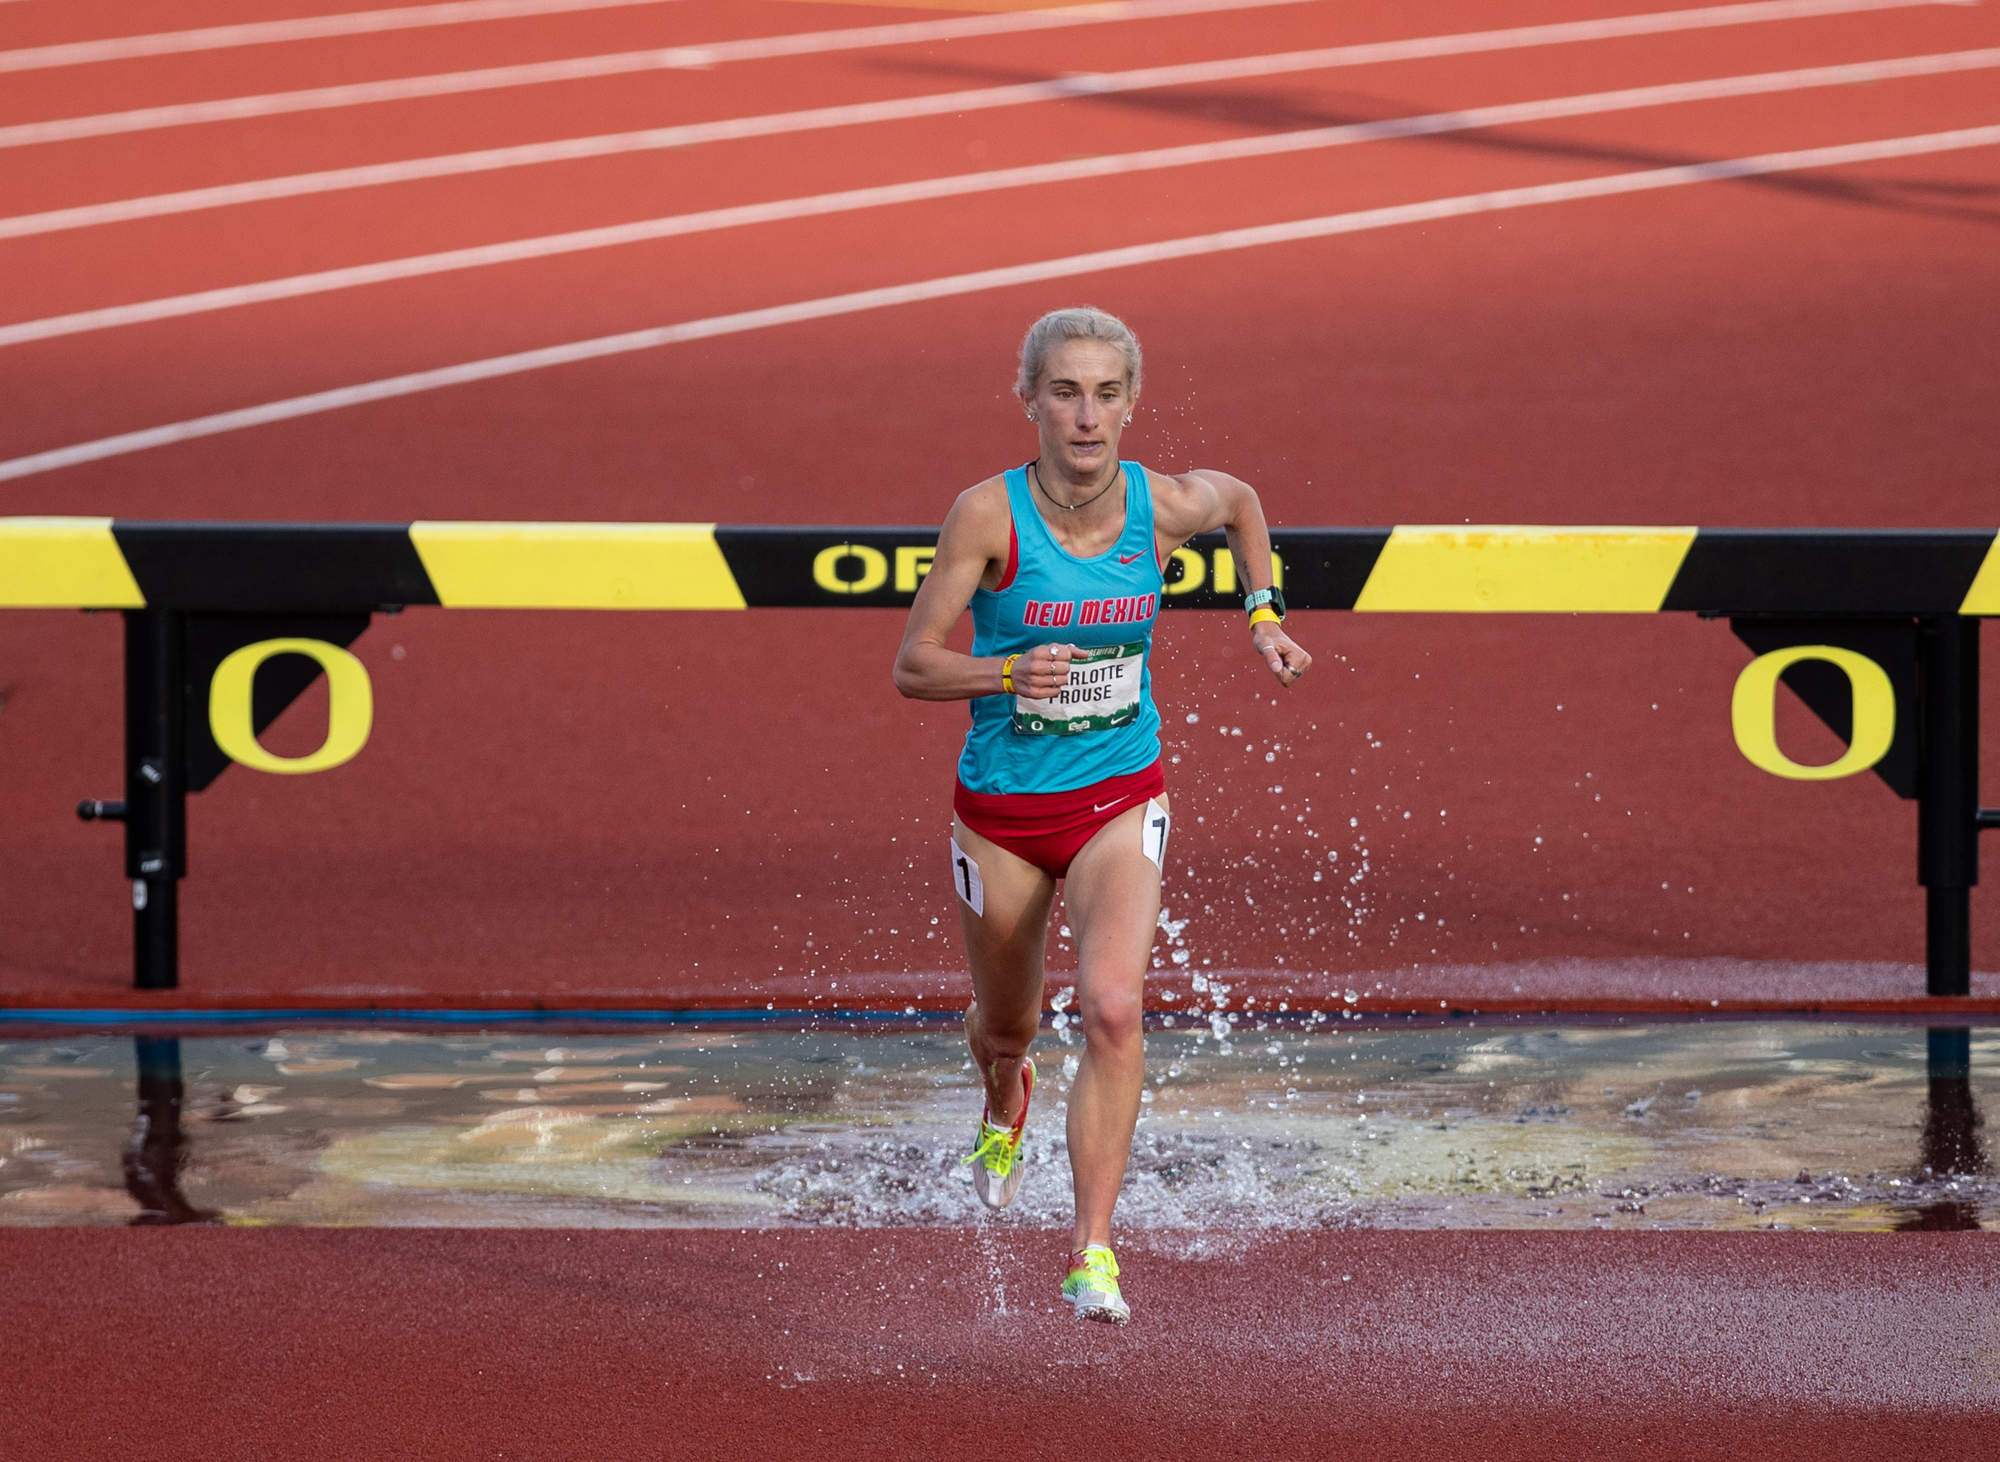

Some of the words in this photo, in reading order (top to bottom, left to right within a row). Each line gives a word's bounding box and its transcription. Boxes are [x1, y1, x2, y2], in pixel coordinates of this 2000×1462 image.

[813, 544, 1283, 594] ORON
[1023, 599, 1073, 627] NEW
[1078, 593, 1156, 626] MEXICO
[1065, 664, 1124, 685] RLOTTE
[208, 637, 373, 775] O
[1731, 644, 1896, 780] O
[956, 856, 972, 903] 1
